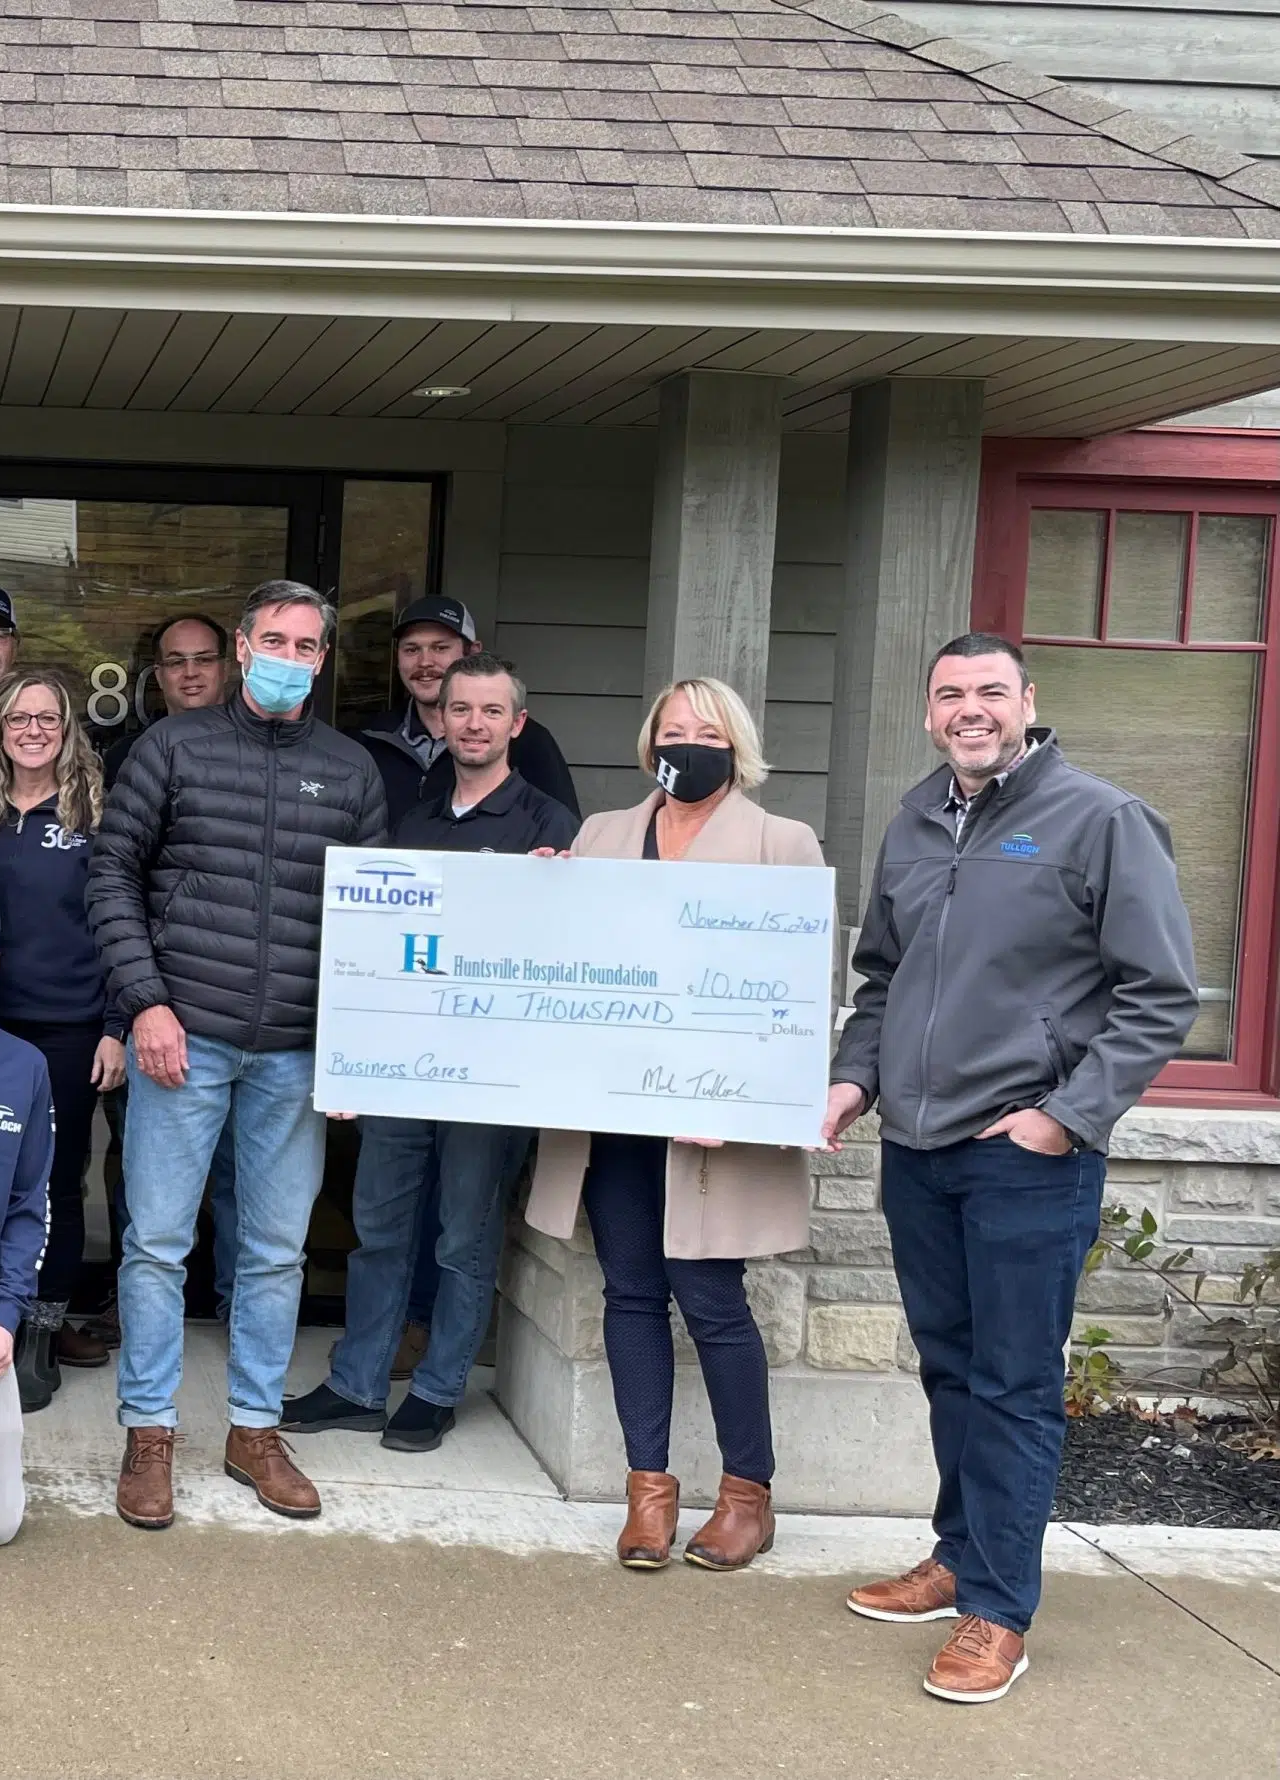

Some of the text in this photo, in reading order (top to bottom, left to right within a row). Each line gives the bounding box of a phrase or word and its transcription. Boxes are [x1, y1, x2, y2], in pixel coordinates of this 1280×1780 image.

[336, 885, 434, 907] TULLOCH
[678, 899, 754, 928] November
[453, 954, 659, 988] Huntsville Hospital Foundation
[431, 987, 494, 1016] TEN
[516, 991, 675, 1025] THOUSAND
[772, 1023, 816, 1036] Dollars
[326, 1052, 469, 1080] Business Cares
